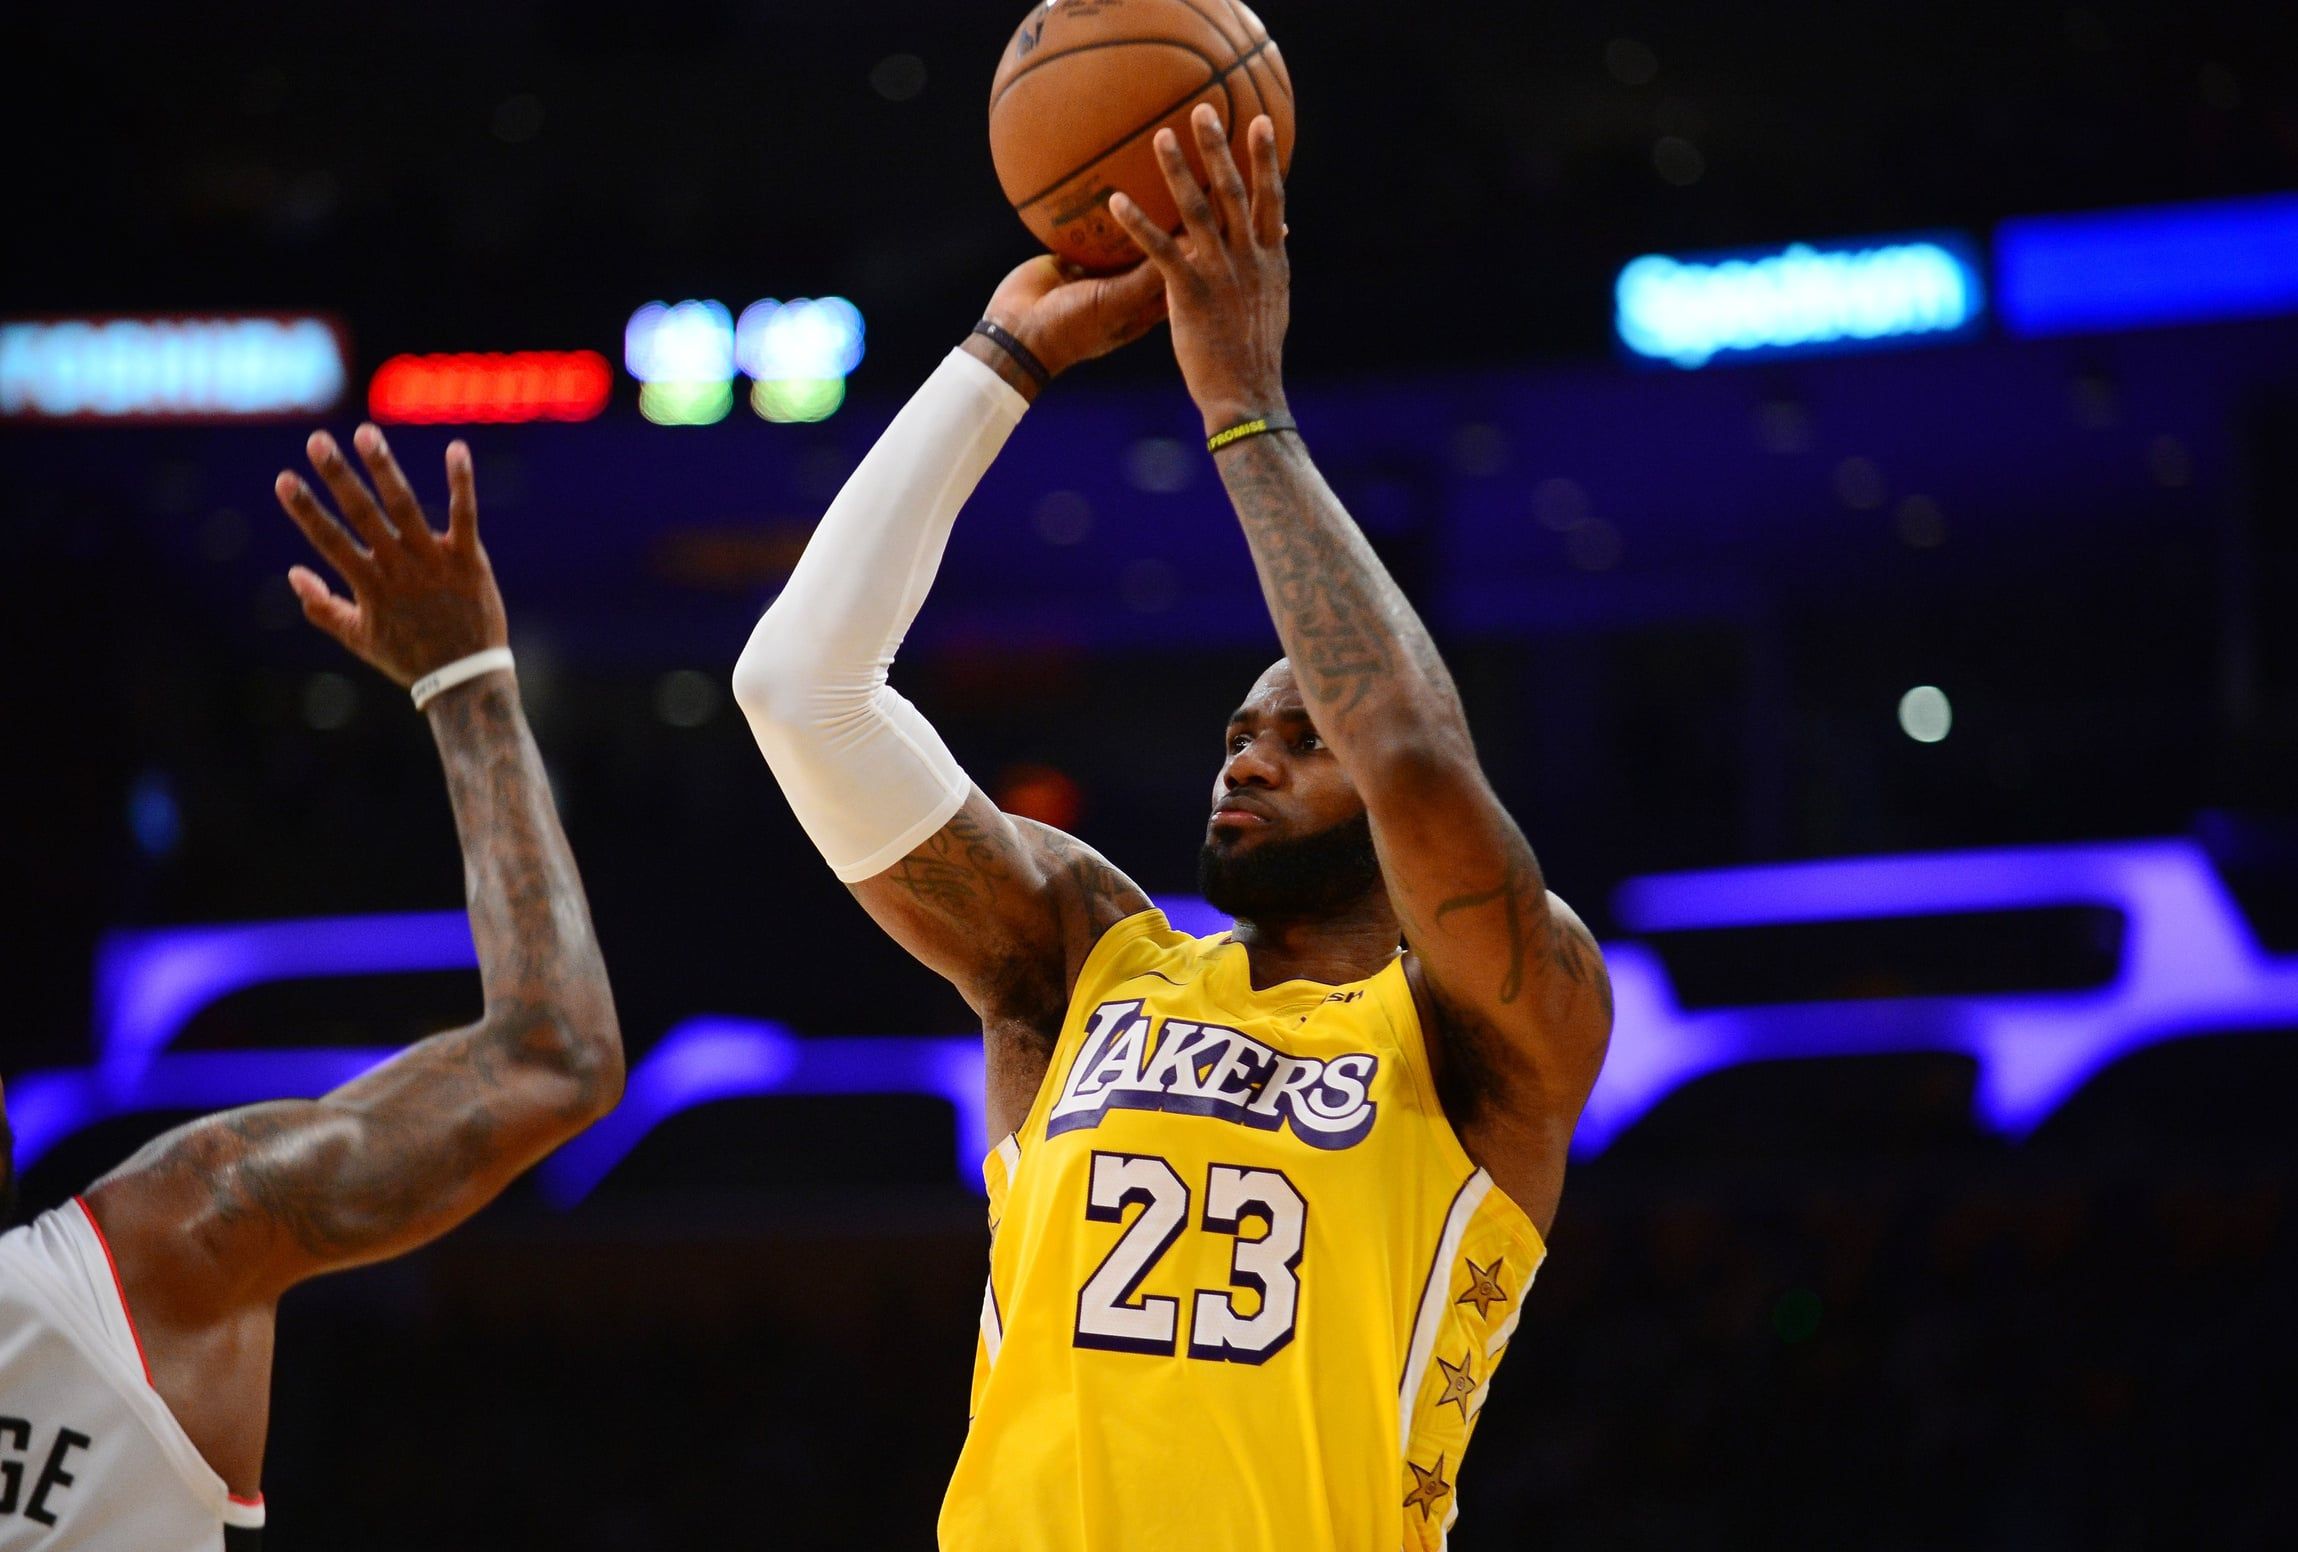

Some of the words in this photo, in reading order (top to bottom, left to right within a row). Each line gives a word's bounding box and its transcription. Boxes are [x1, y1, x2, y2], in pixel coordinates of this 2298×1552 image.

[1209, 419, 1266, 450] PROMISE
[1046, 998, 1379, 1151] LAKERS
[1073, 1149, 1309, 1366] 23
